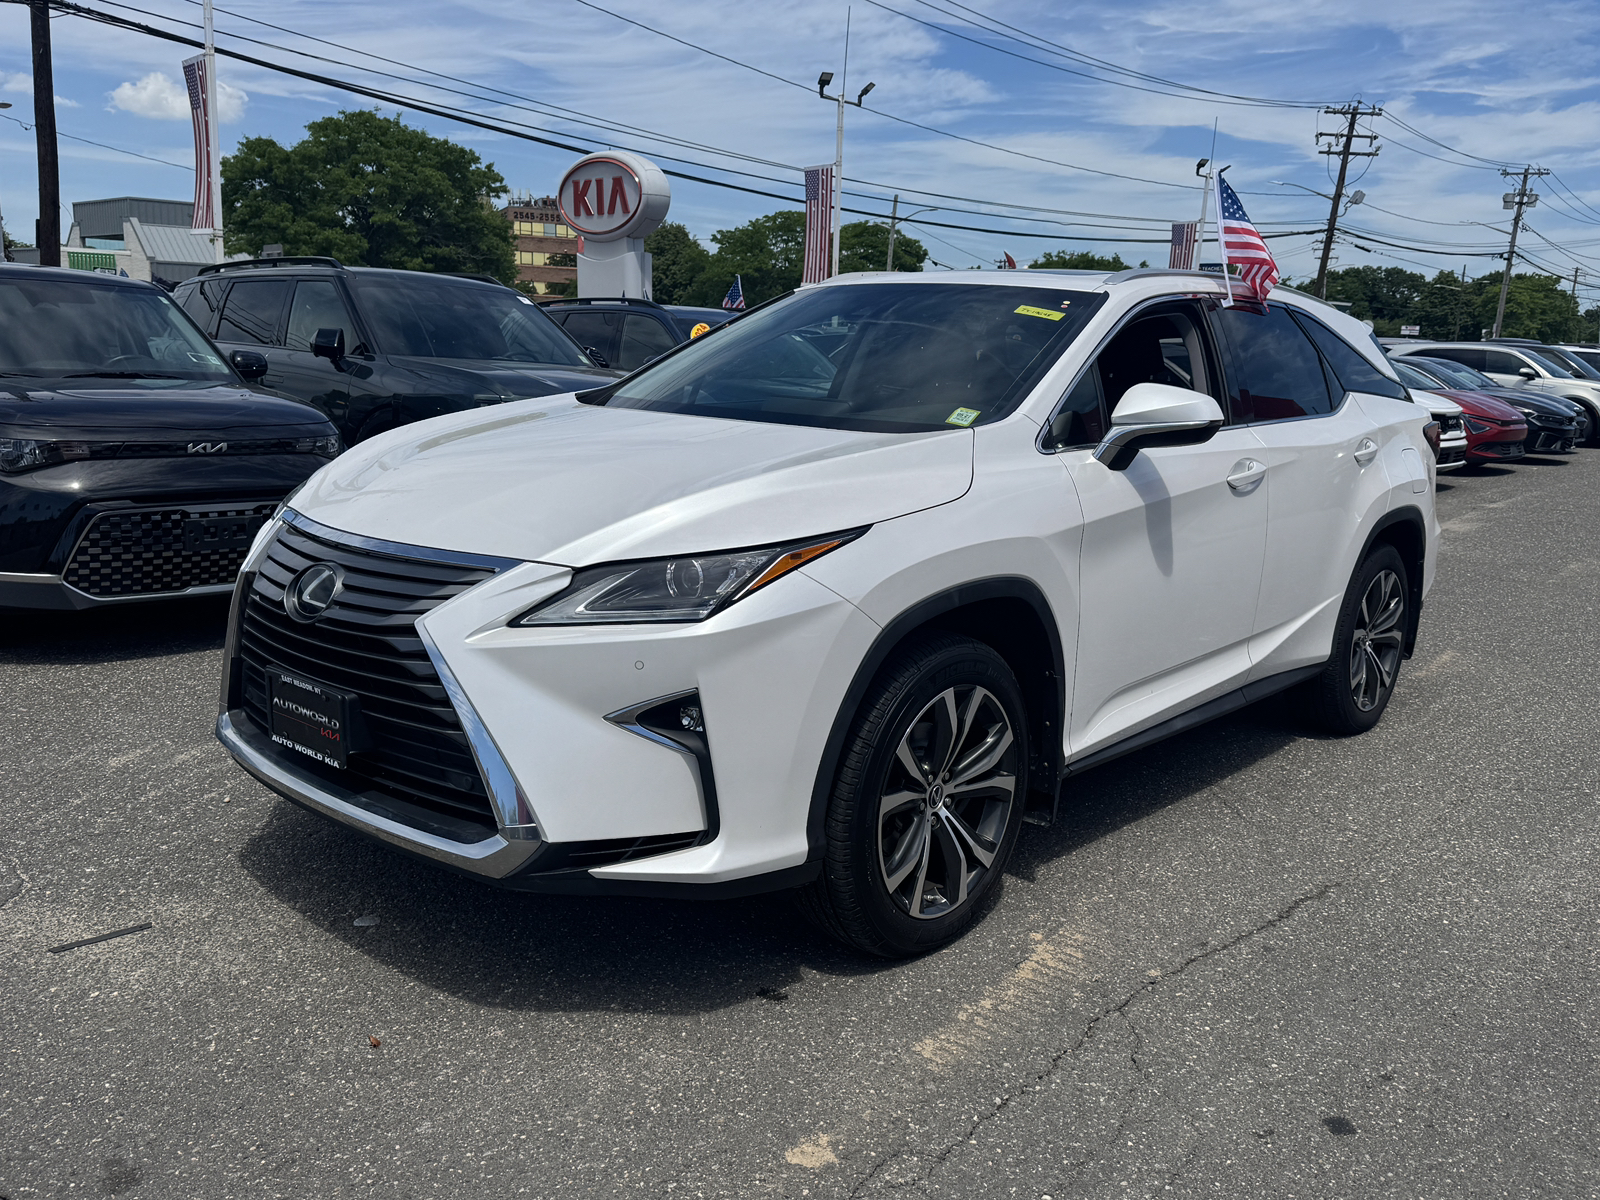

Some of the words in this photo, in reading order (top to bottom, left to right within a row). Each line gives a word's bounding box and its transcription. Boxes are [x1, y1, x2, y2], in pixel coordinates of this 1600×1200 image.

[572, 176, 630, 216] KIA
[513, 211, 561, 222] 2545-2555
[187, 442, 228, 454] KIA
[273, 696, 340, 730] AUTOWORLD
[320, 727, 341, 741] KIA
[271, 734, 293, 748] AUTO
[294, 743, 323, 761] WORLD
[324, 756, 340, 769] KIA
